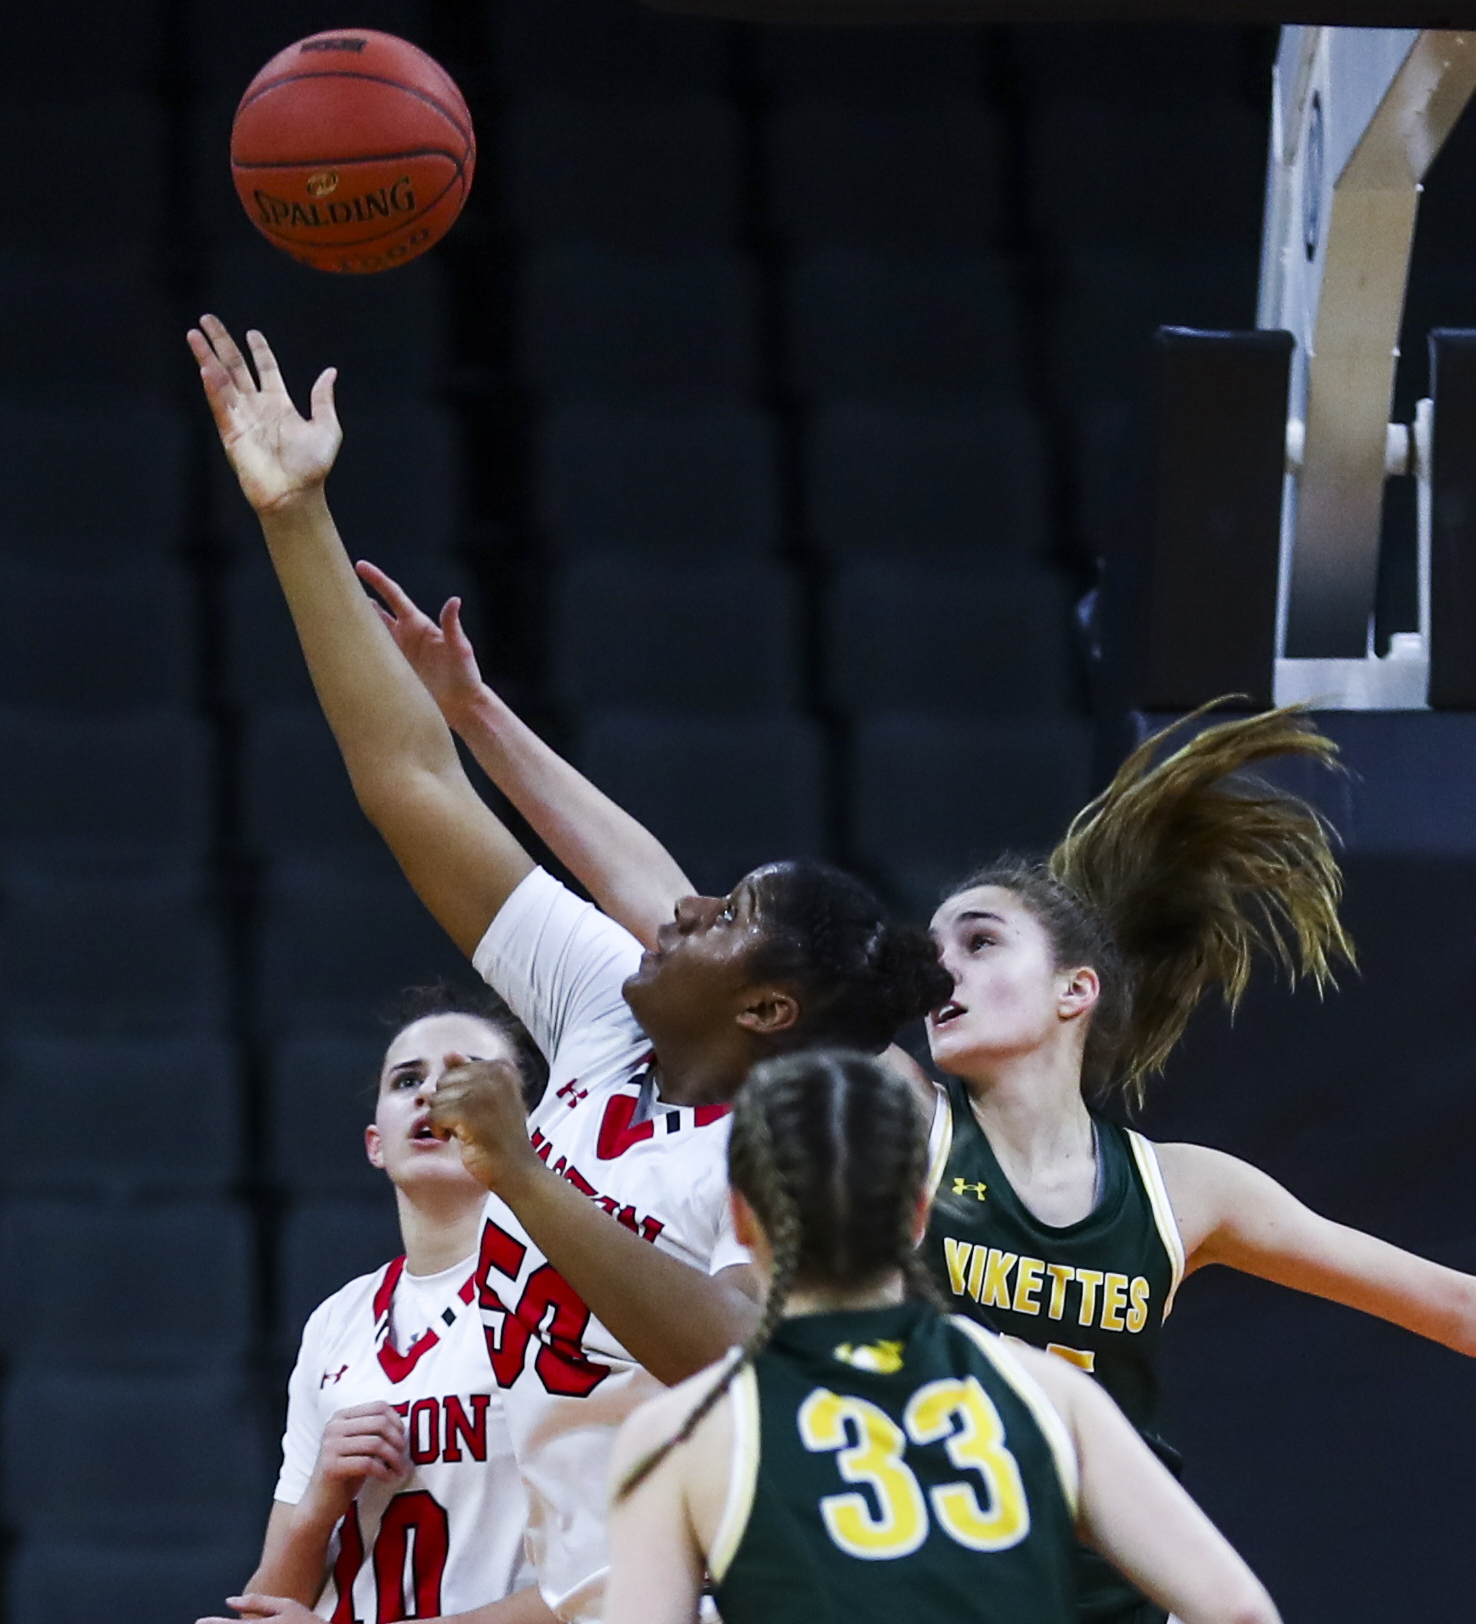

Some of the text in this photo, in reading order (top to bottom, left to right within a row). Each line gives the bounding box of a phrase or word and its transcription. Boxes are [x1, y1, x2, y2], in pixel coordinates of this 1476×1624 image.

[253, 176, 417, 227] SPALDING
[474, 1217, 611, 1398] 50
[943, 1236, 1150, 1334] VIKETTES
[389, 1394, 491, 1466] ON
[796, 1373, 1031, 1561] 33
[328, 1489, 450, 1622] 10
